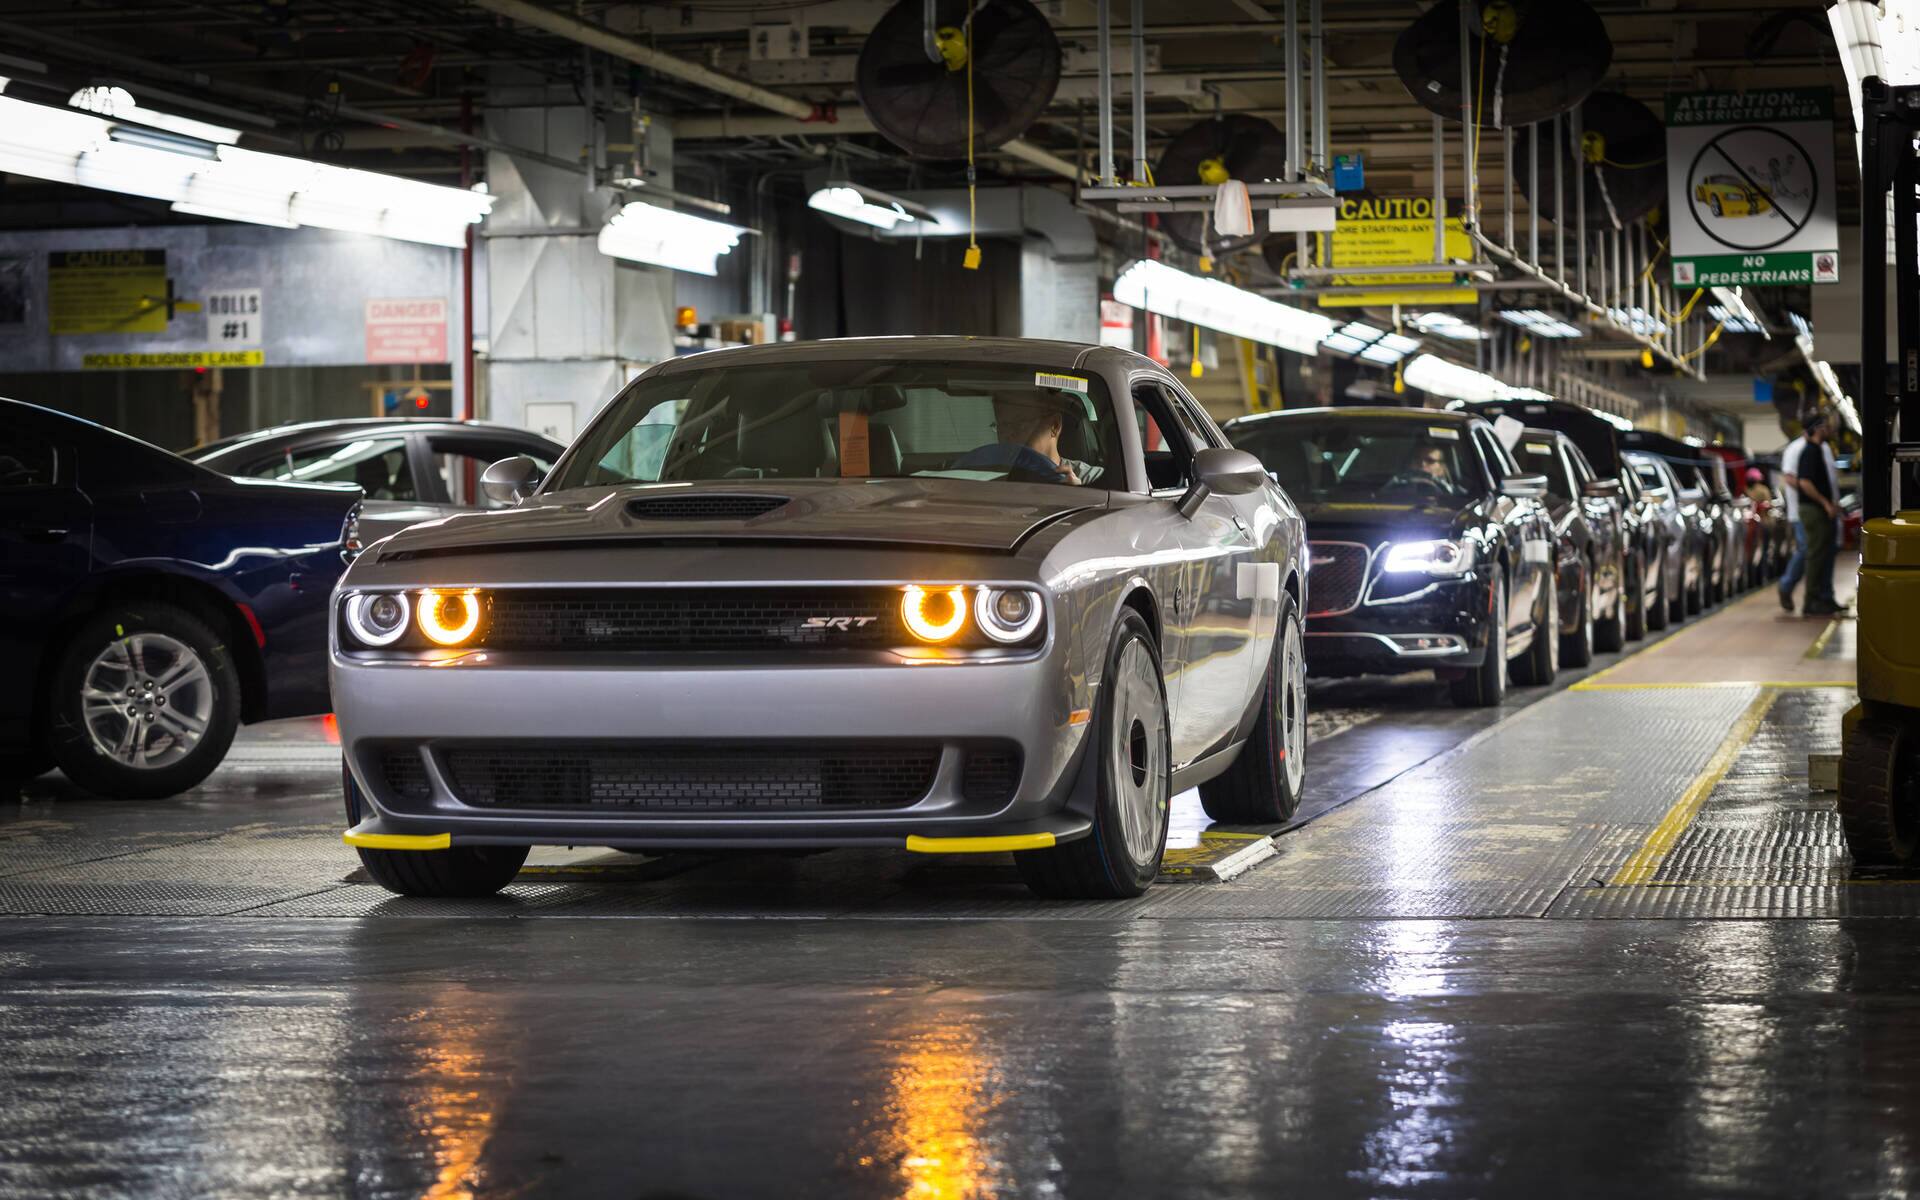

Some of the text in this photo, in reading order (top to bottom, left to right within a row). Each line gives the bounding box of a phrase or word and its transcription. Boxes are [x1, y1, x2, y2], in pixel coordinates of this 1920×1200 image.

[1673, 105, 1821, 122] RESTRICTED AREA
[1361, 224, 1408, 233] STARTING
[1412, 224, 1430, 232] ANY
[65, 251, 146, 266] CAUTION
[1743, 256, 1766, 268] NO
[1699, 269, 1810, 286] PEDESTRIANS
[210, 295, 258, 315] ROLLS
[371, 303, 441, 319] DANGER
[222, 320, 248, 339] #1
[209, 352, 247, 365] LANE
[801, 616, 877, 631] SRT
